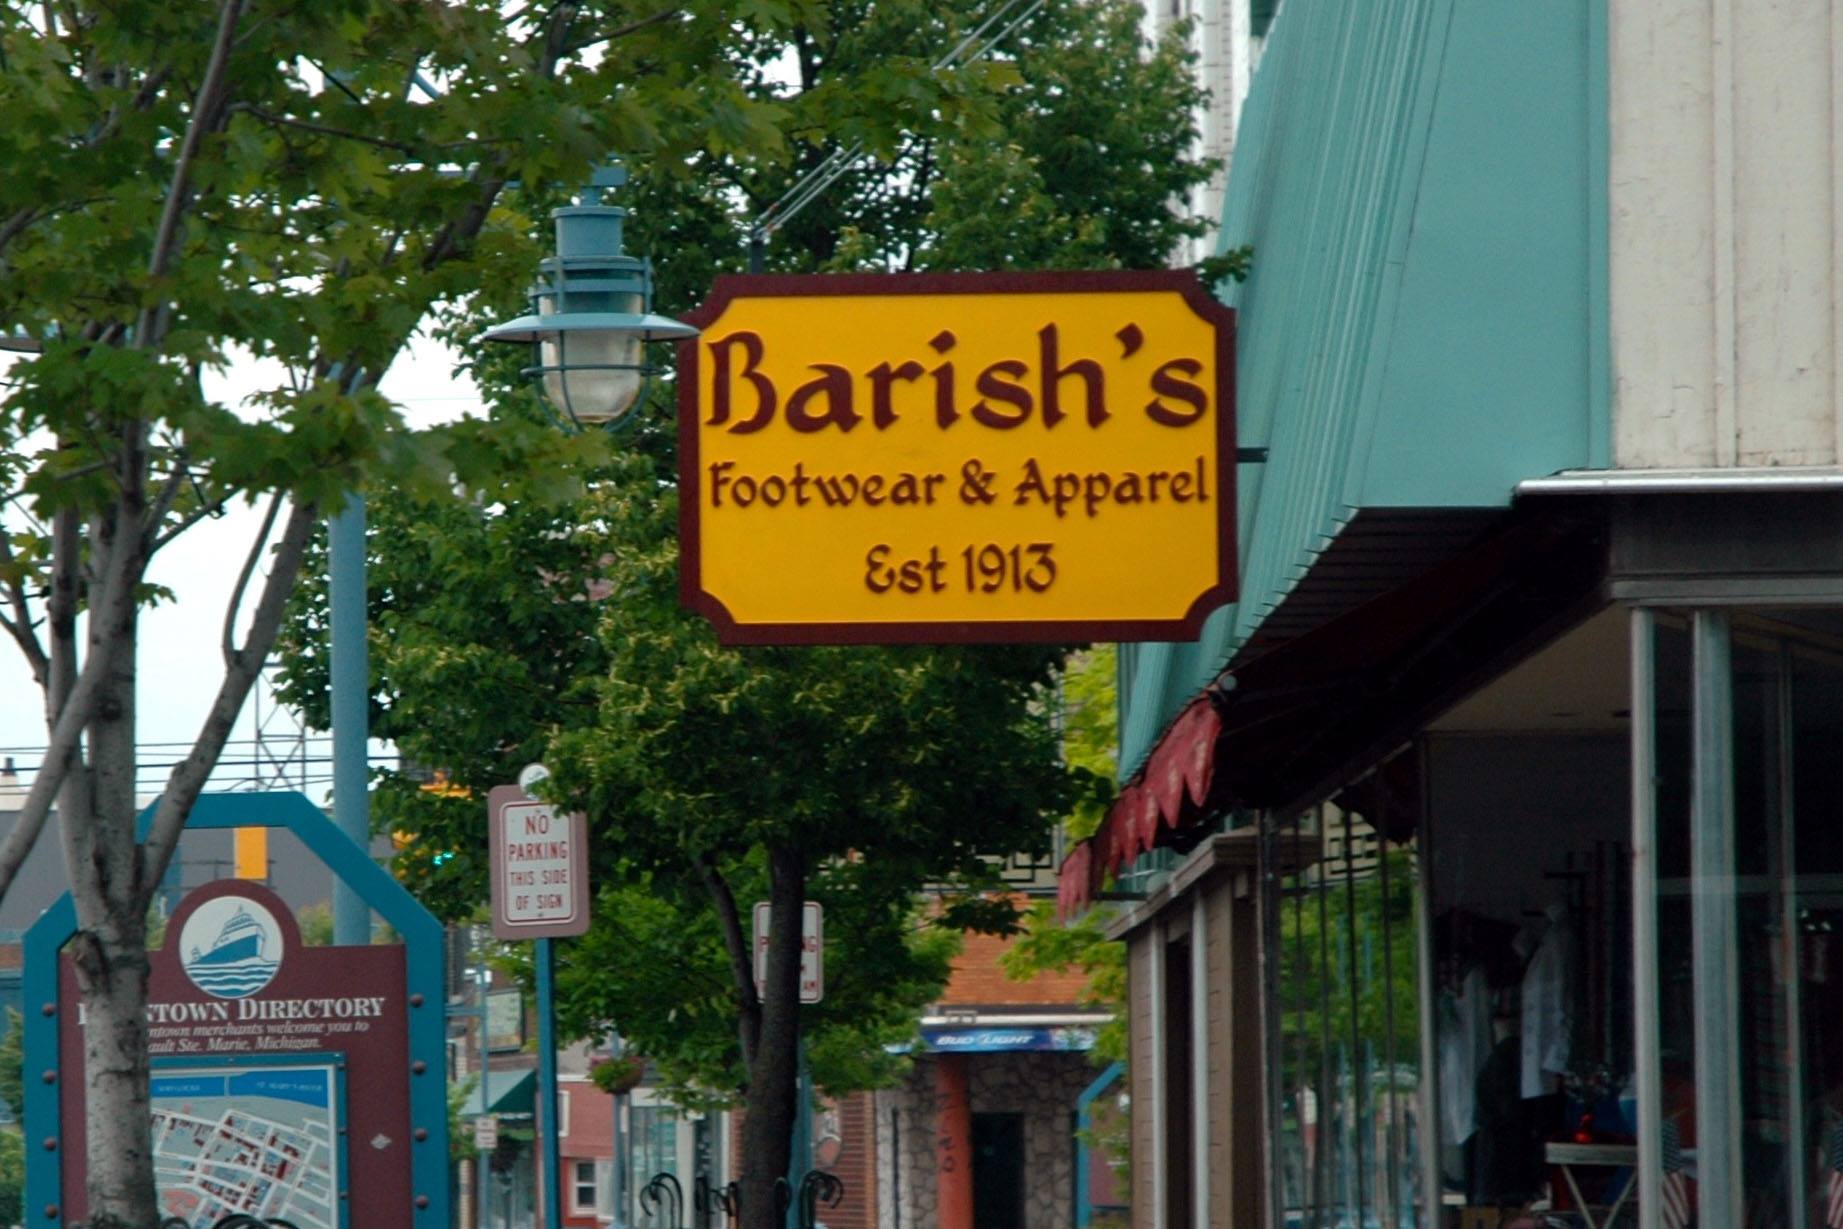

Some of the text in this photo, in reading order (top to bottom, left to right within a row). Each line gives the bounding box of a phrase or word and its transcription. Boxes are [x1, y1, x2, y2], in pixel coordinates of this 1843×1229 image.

[705, 322, 1208, 434] Barish's
[708, 456, 1209, 518] Footwear & Apparel
[865, 542, 1057, 594] Est 1913
[526, 815, 548, 834] NO
[509, 841, 568, 861] PARKING
[511, 869, 567, 885] THIS SIDE
[516, 894, 562, 910] OF SIGN
[238, 997, 385, 1020] DIRECTORY
[266, 1020, 324, 1034] welcome
[326, 1022, 352, 1036] you
[354, 1021, 370, 1032] to
[148, 1039, 175, 1052] ault
[936, 1035, 1034, 1046] BUD LIGHT
